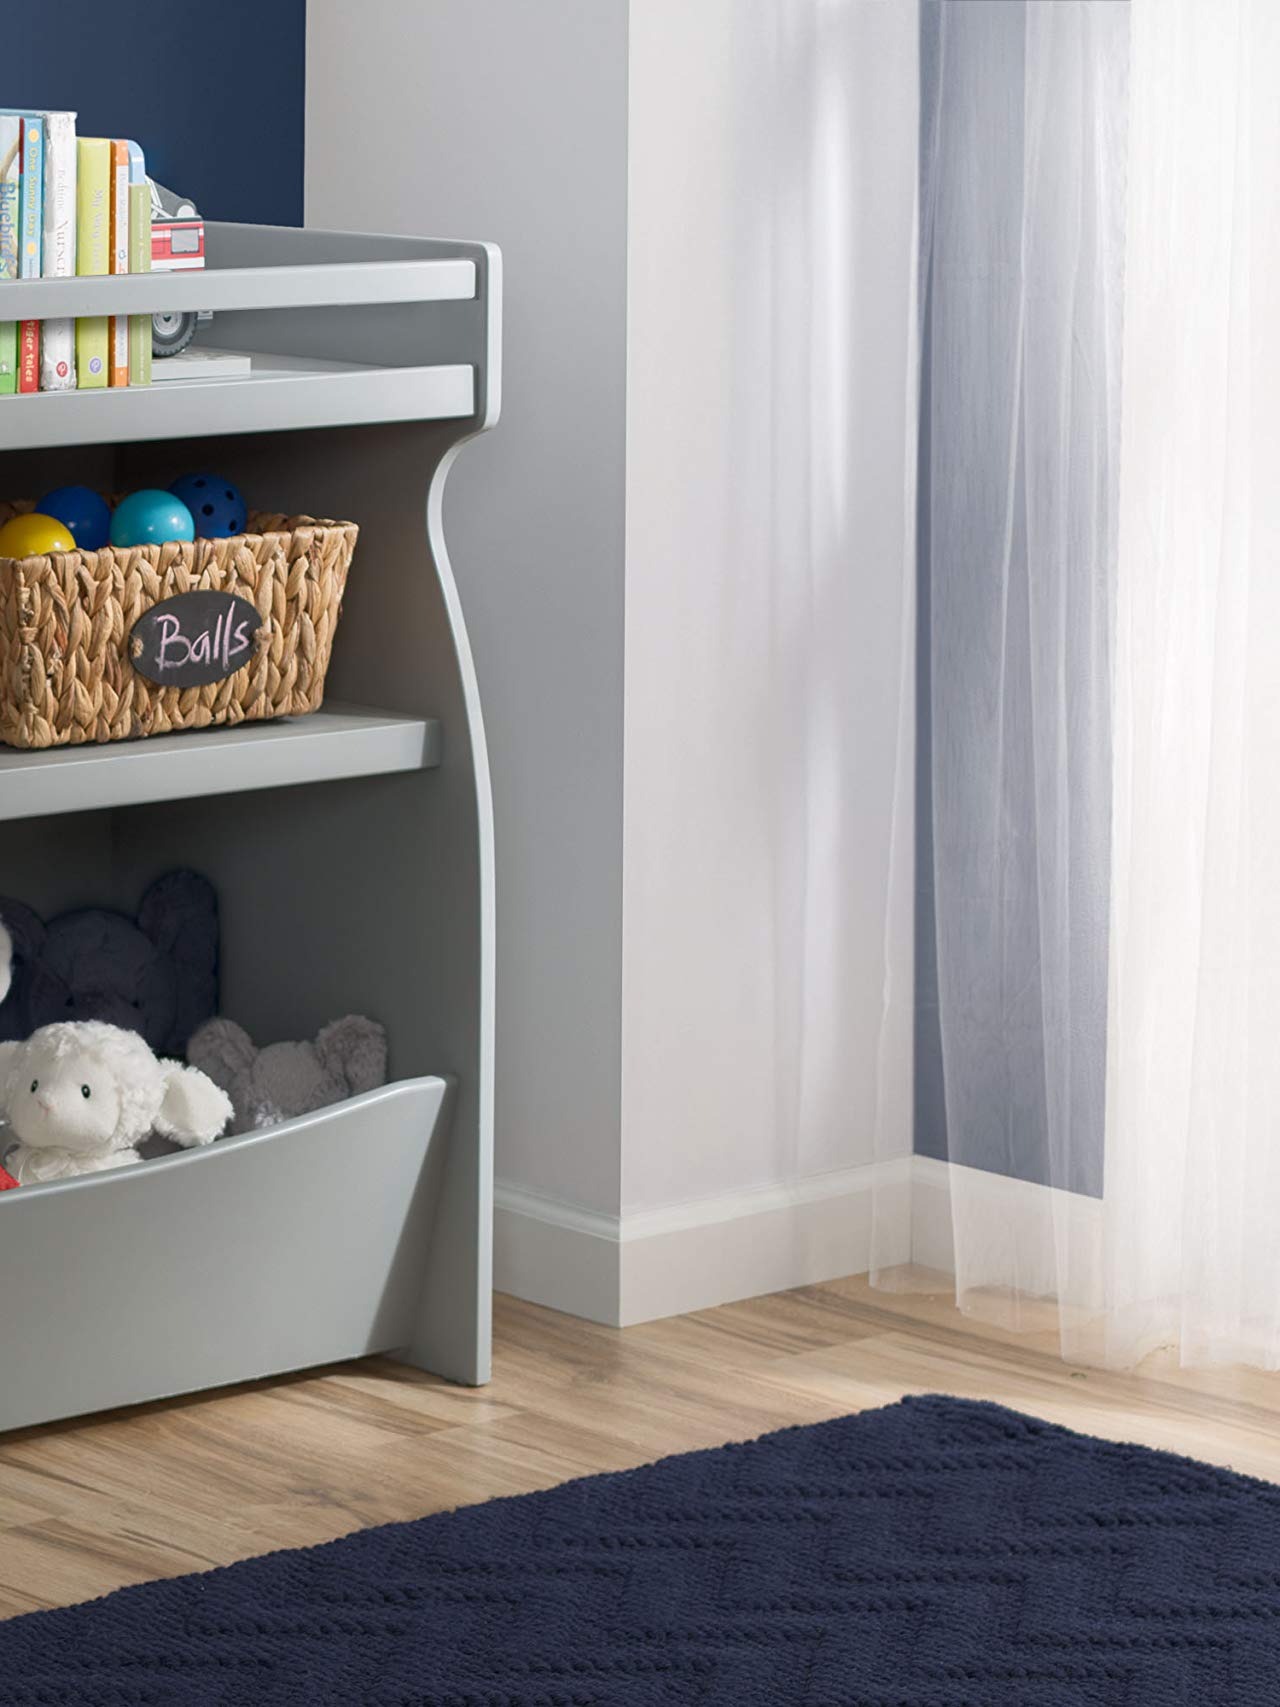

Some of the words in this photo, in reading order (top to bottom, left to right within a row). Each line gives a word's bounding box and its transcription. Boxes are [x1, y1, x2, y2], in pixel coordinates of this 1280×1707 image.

[29, 147, 38, 172] One
[27, 176, 37, 210] Sunny
[27, 213, 38, 238] Day
[55, 220, 69, 275] Nurser
[24, 320, 36, 350] tiger
[24, 353, 36, 383] tales
[154, 600, 254, 673] Balls
